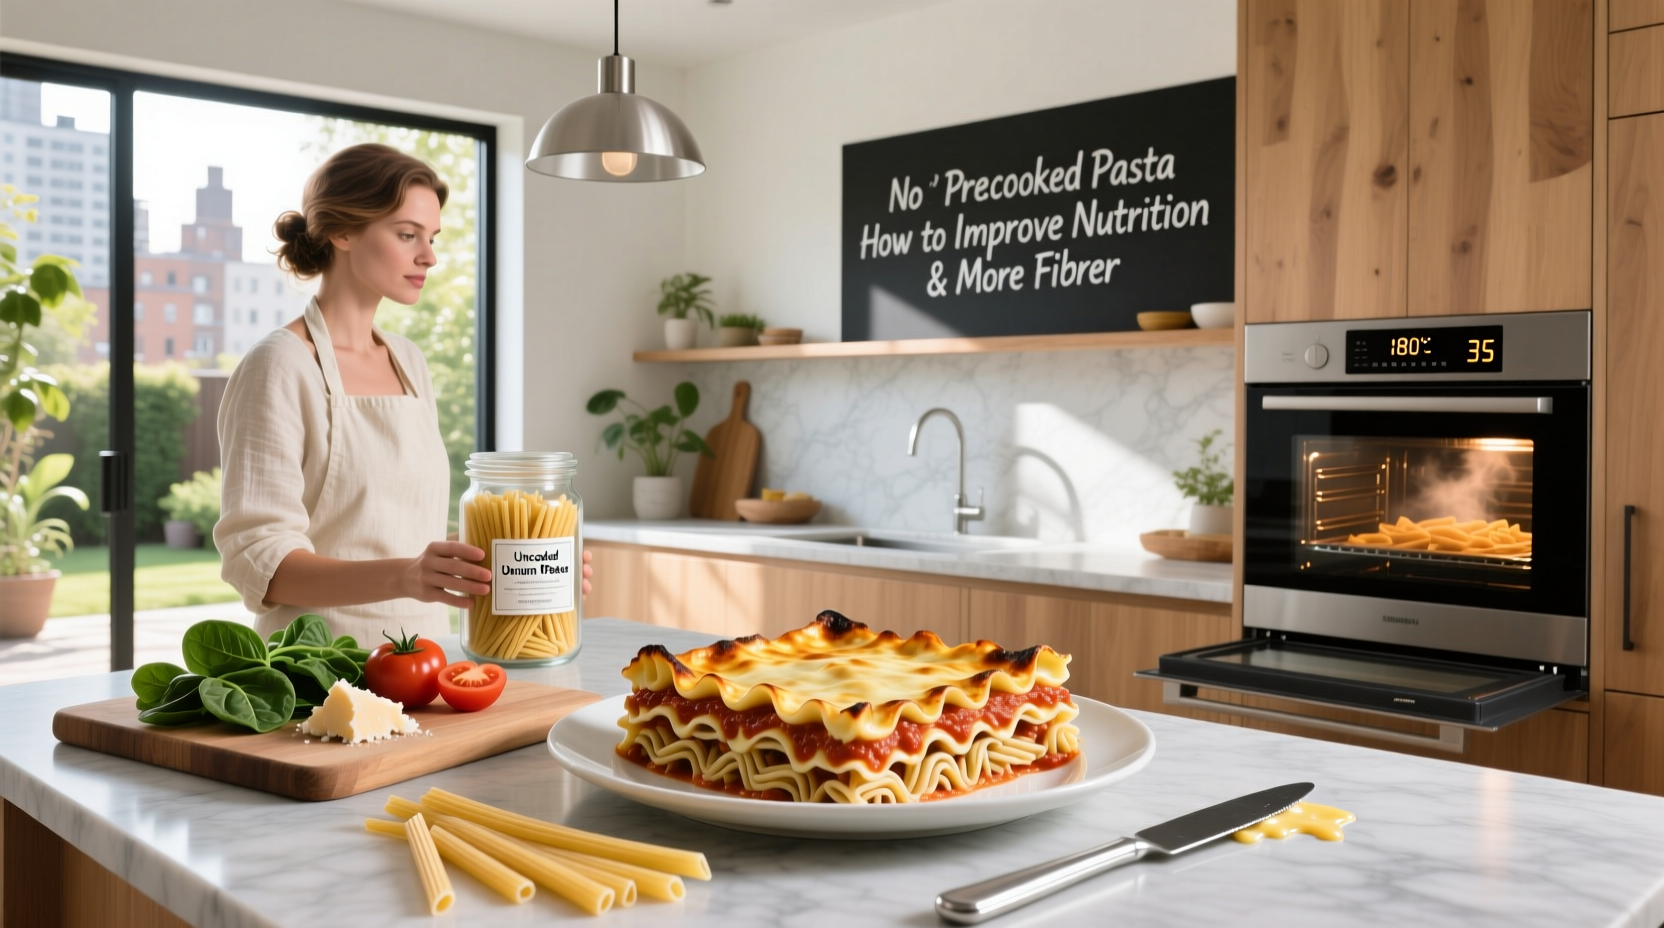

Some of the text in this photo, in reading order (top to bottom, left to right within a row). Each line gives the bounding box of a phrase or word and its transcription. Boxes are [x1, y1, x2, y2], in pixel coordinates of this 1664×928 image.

[888, 175, 924, 213] No
[944, 150, 1085, 206] Precooked
[1091, 147, 1176, 190] Pasta
[859, 193, 1210, 261] How to Improve Nutrition
[926, 248, 1121, 298] & More Fibrer
[1467, 339, 1495, 363] 35
